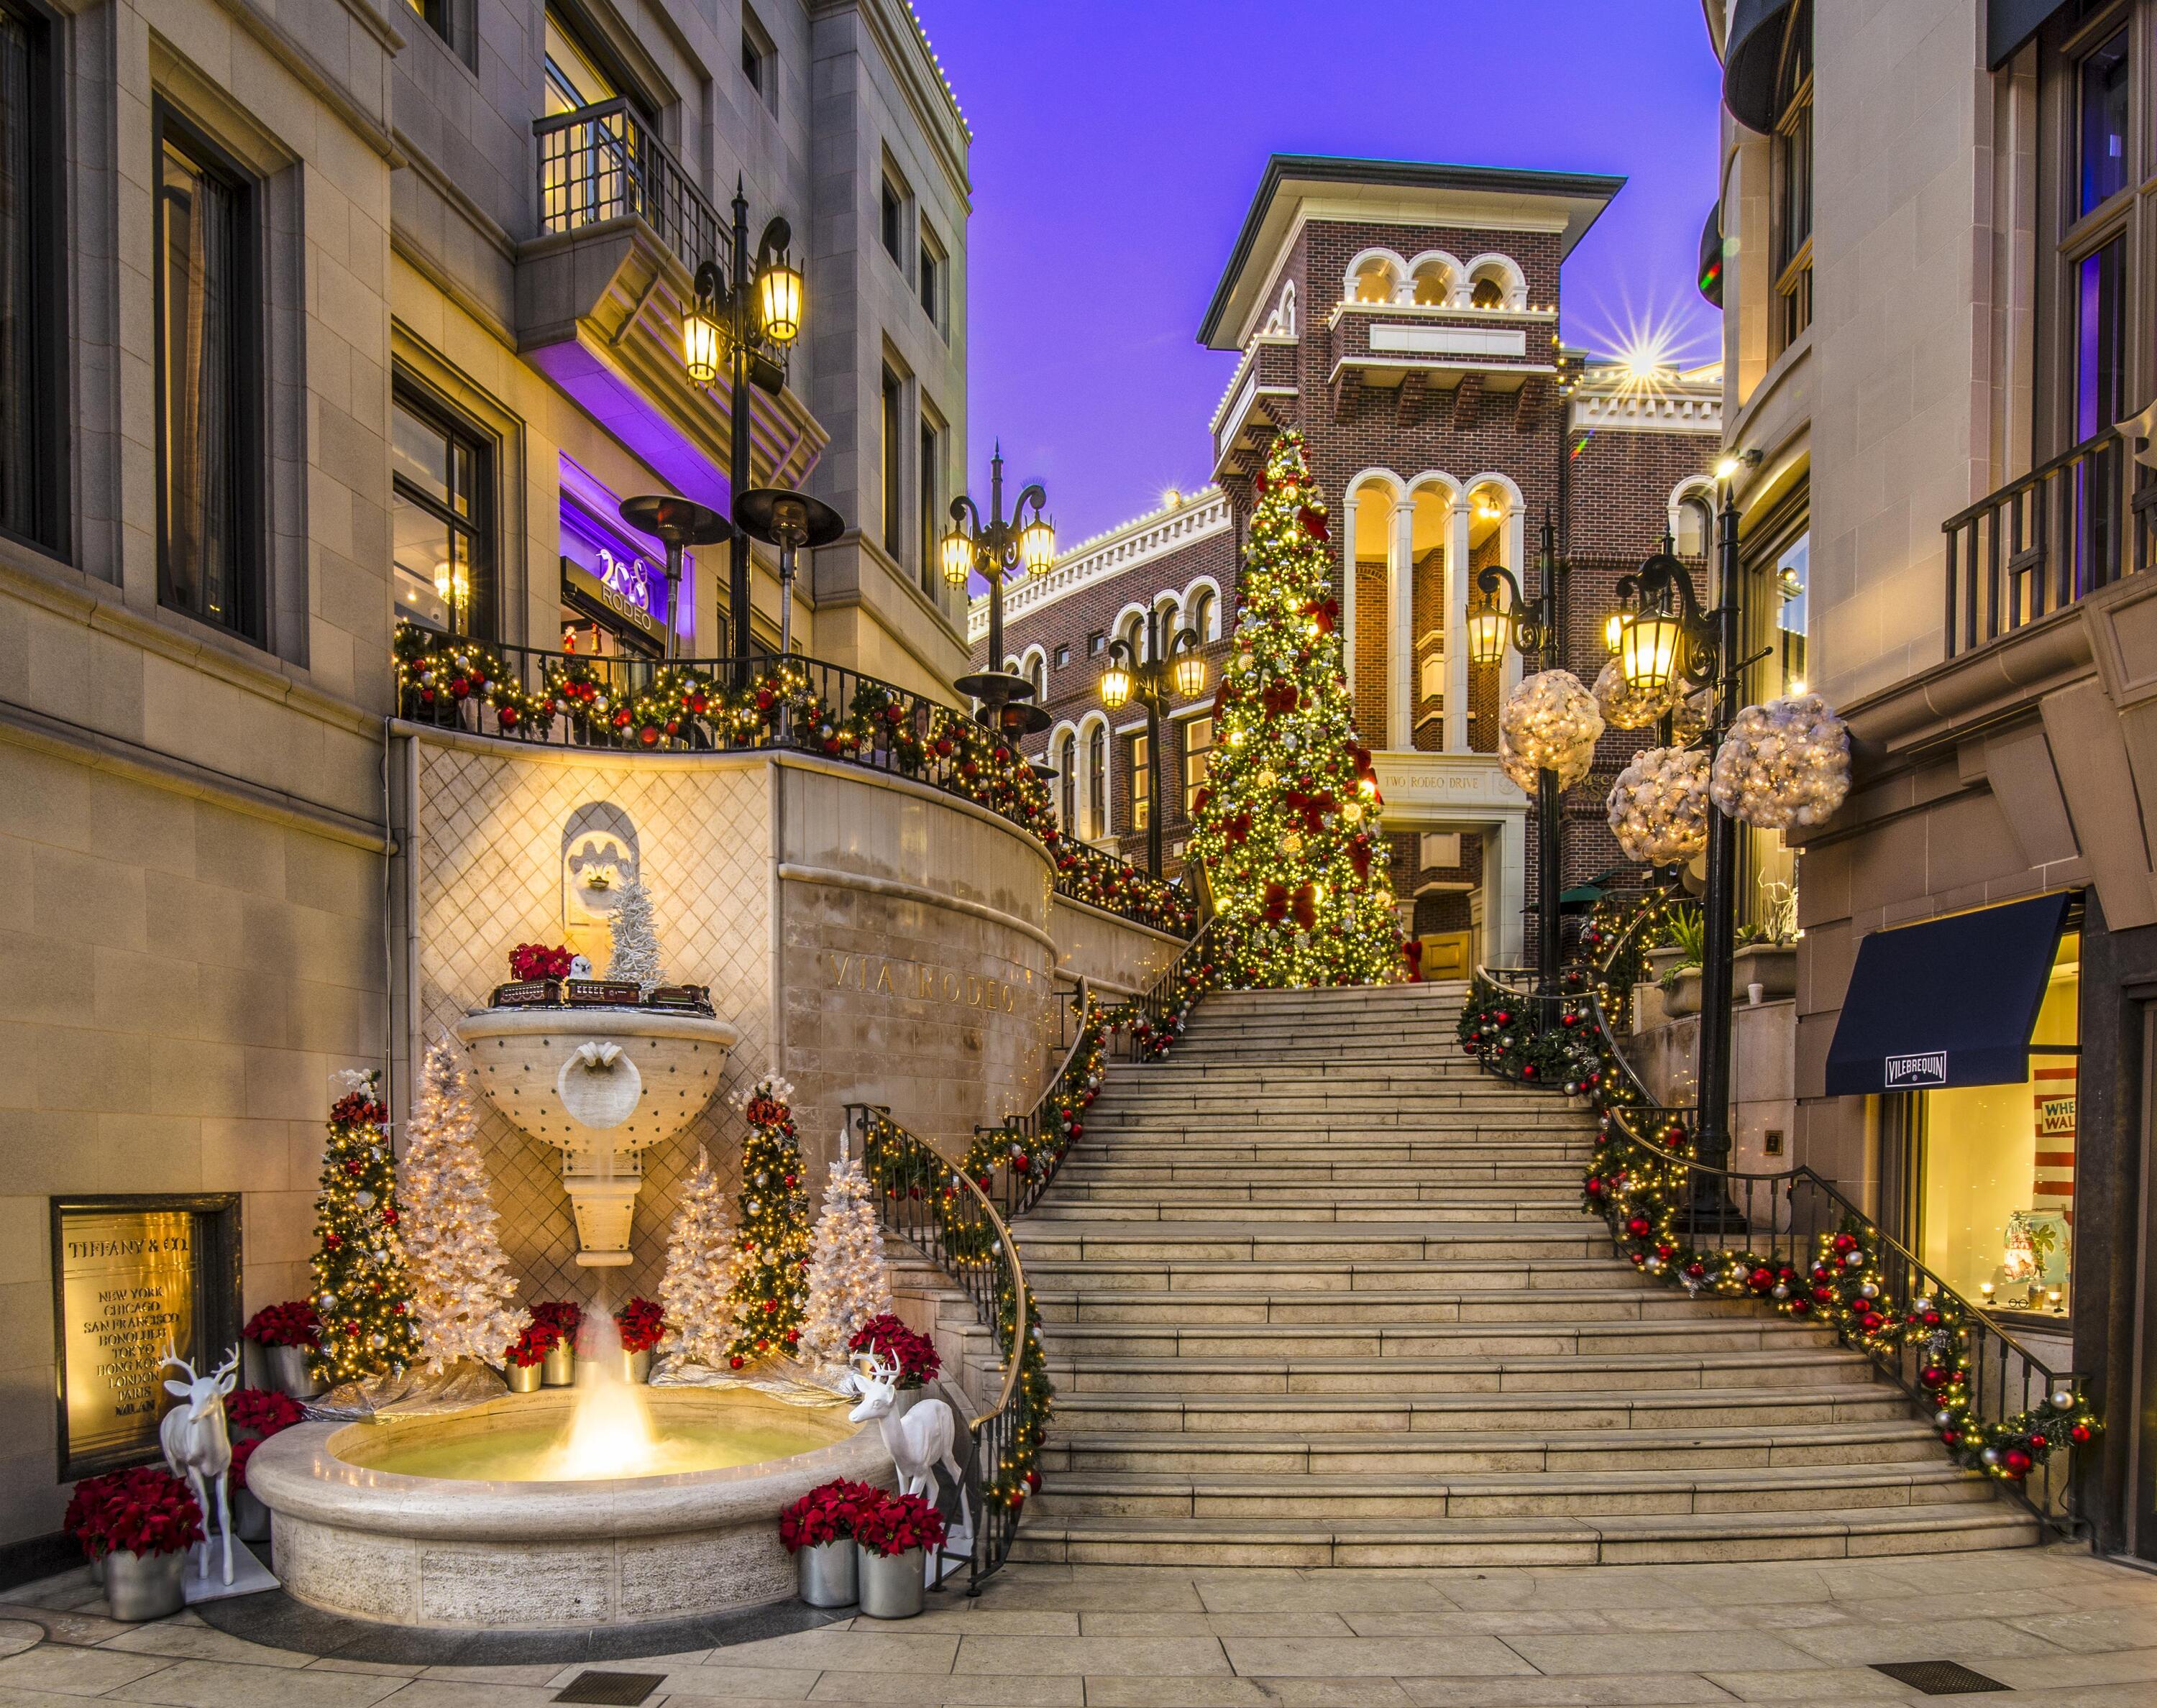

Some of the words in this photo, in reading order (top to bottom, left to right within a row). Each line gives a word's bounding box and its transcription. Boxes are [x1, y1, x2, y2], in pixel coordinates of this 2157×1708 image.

[595, 548, 649, 611] 208
[601, 584, 651, 630] RODEO
[1385, 776, 1406, 788] TWO
[1411, 776, 1444, 789] RODEO
[1449, 777, 1478, 789] DRIVE
[830, 954, 894, 993] VIA
[919, 965, 1015, 1012] RODEO
[1888, 1055, 1943, 1083] VILEBREQUIN
[2045, 1101, 2075, 1116] WHE
[69, 1239, 145, 1258] TIFFANY
[148, 1239, 159, 1252] &
[163, 1236, 189, 1252] CO.
[99, 1289, 127, 1303] NEW
[130, 1286, 164, 1300] YORK
[104, 1301, 160, 1316] CHICAGO
[83, 1321, 109, 1333] SAN
[112, 1313, 180, 1330] FRANCISCO
[99, 1328, 166, 1346] HONOLULU
[112, 1344, 155, 1359] TOKYO
[97, 1361, 132, 1377] HONG
[109, 1371, 160, 1389] LONDON
[118, 1386, 152, 1402] PARIS
[115, 1400, 155, 1417] MILAN
